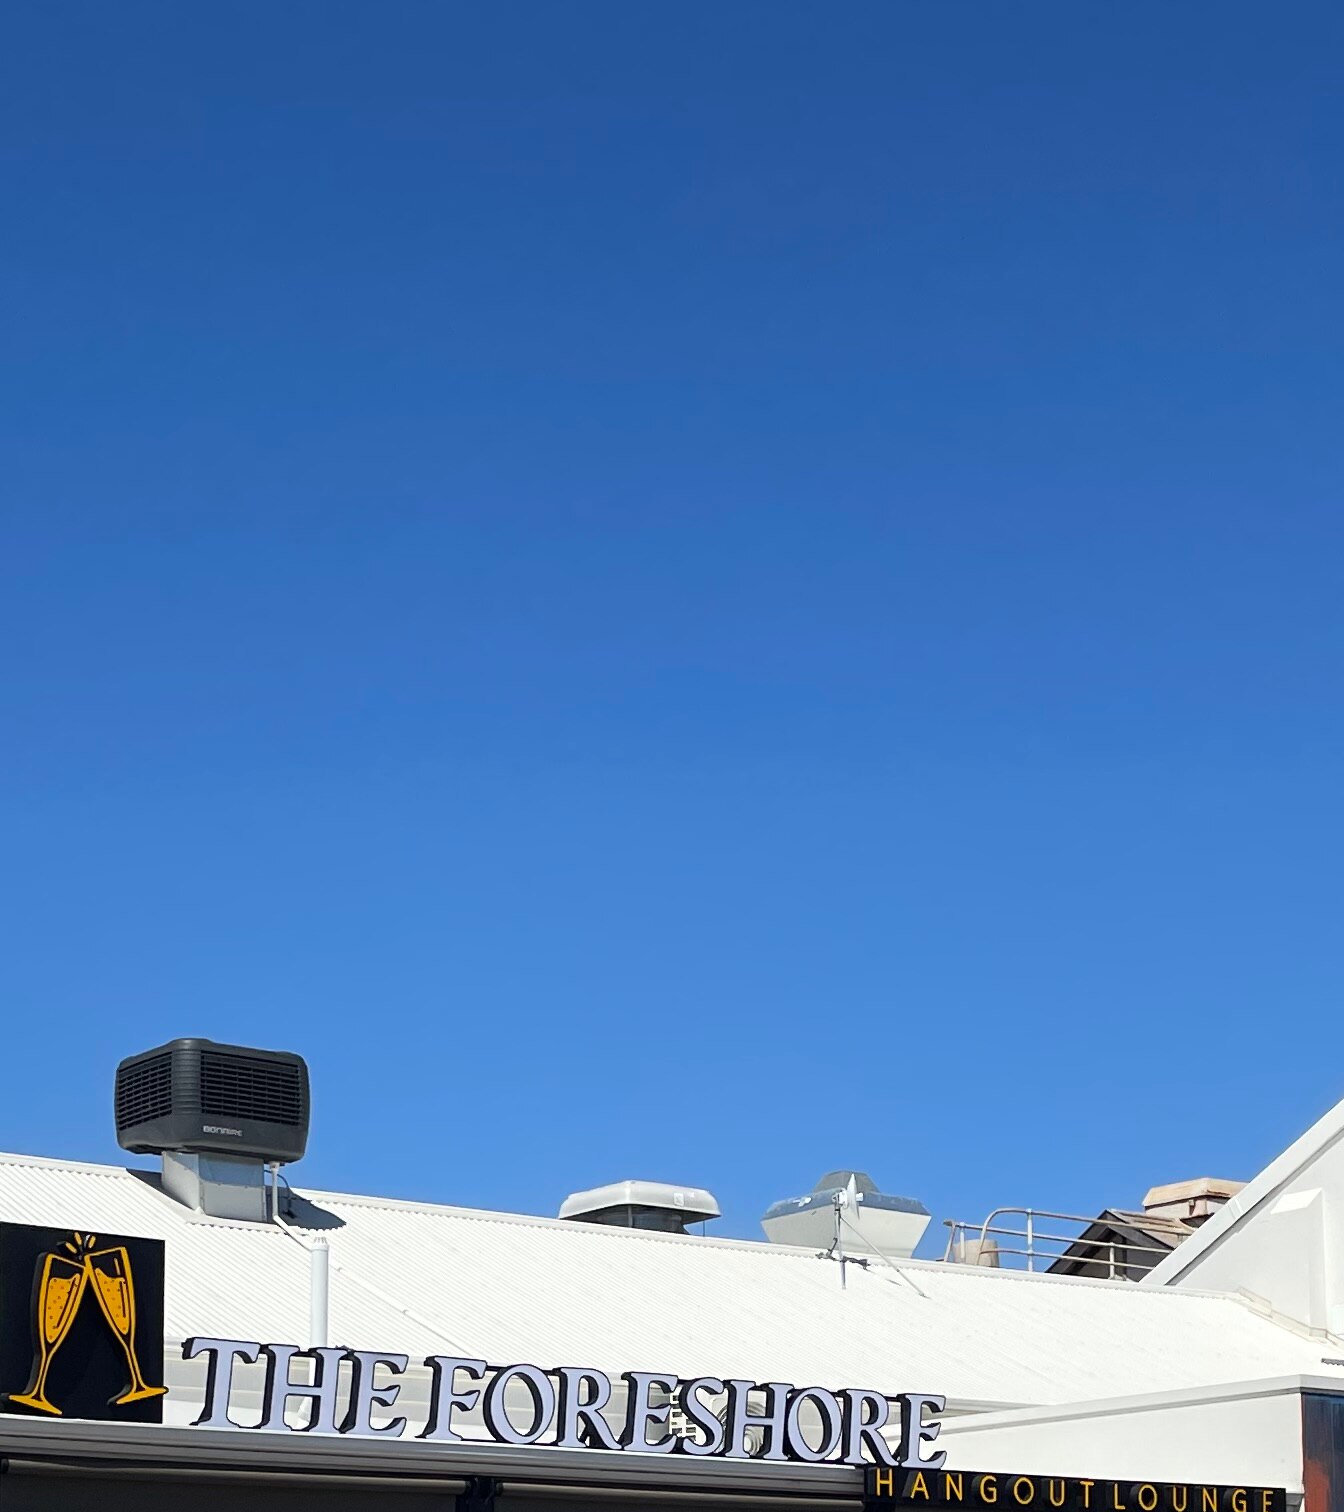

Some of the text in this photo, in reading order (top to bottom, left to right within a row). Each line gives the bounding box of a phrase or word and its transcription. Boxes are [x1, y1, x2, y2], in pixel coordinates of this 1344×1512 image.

[183, 1337, 947, 1470] THE FORESHORE
[875, 1468, 1095, 1508] HANGOUT
